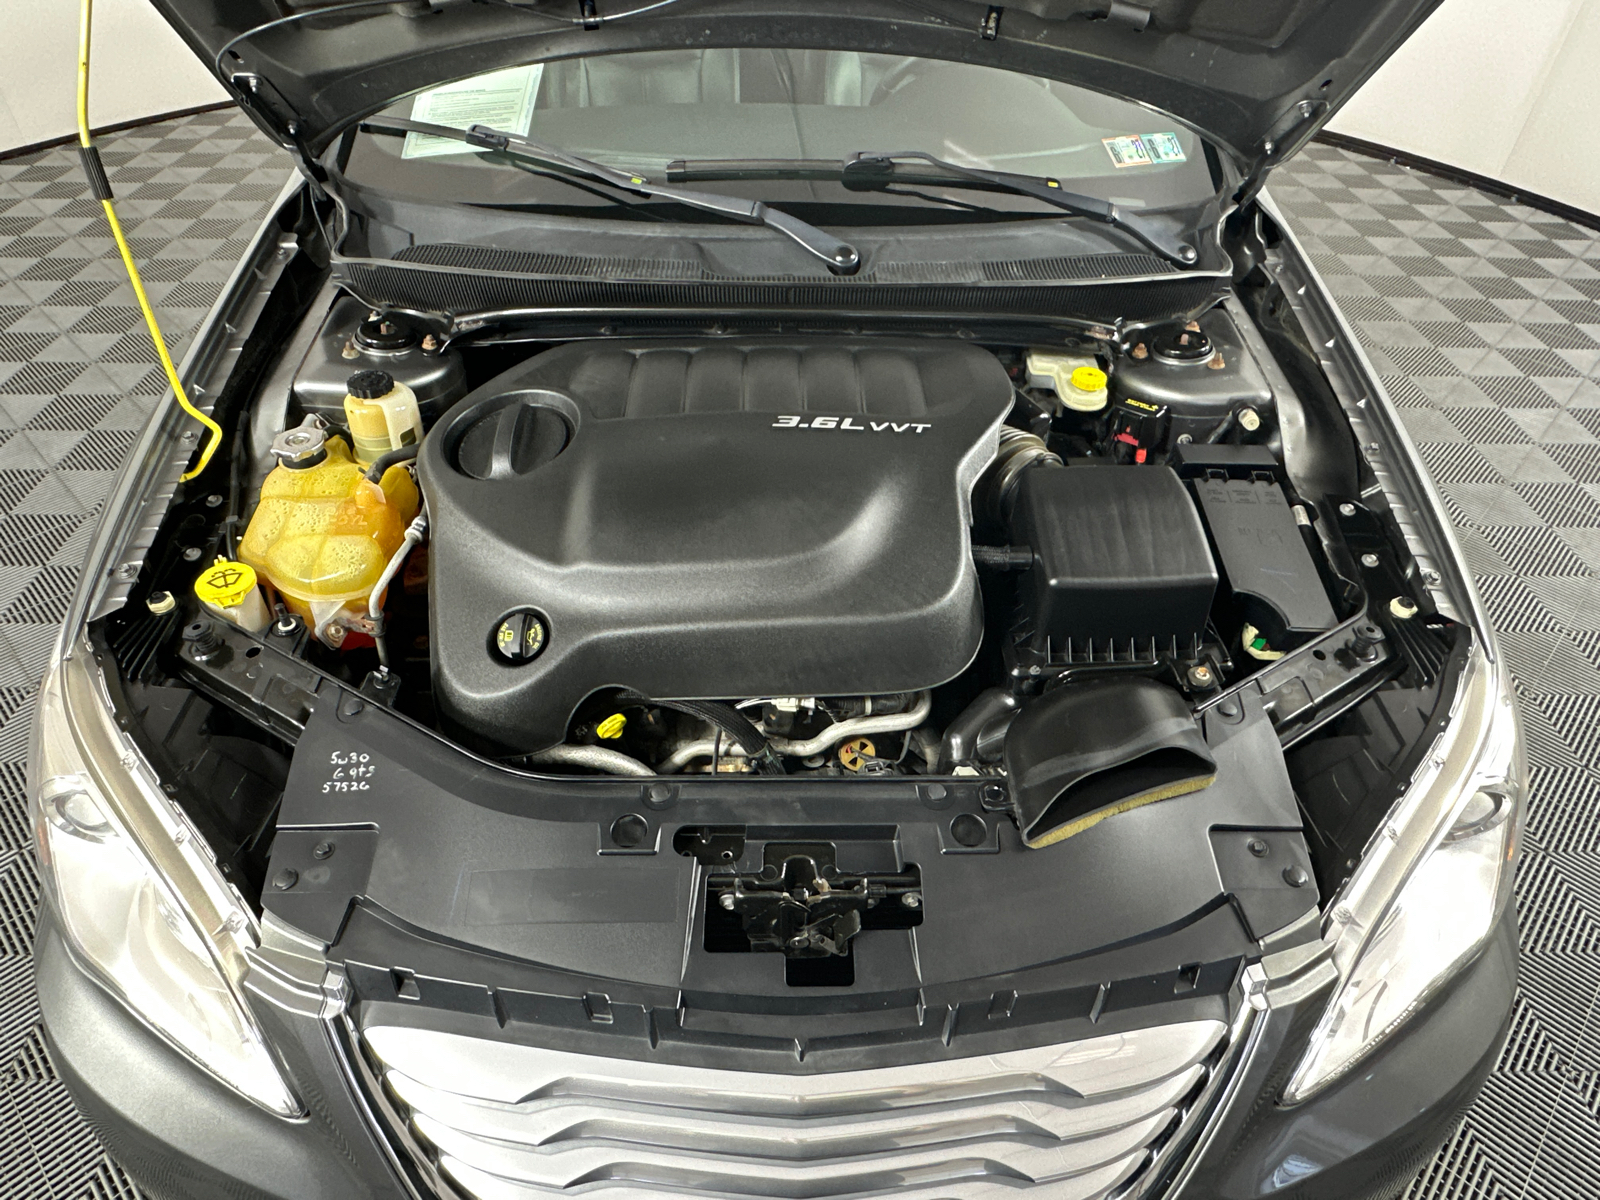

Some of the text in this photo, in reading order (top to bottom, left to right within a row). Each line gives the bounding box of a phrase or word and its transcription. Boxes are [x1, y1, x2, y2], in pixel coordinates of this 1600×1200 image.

[772, 415, 932, 433] 3.6L VVT
[321, 781, 370, 794] 57526
